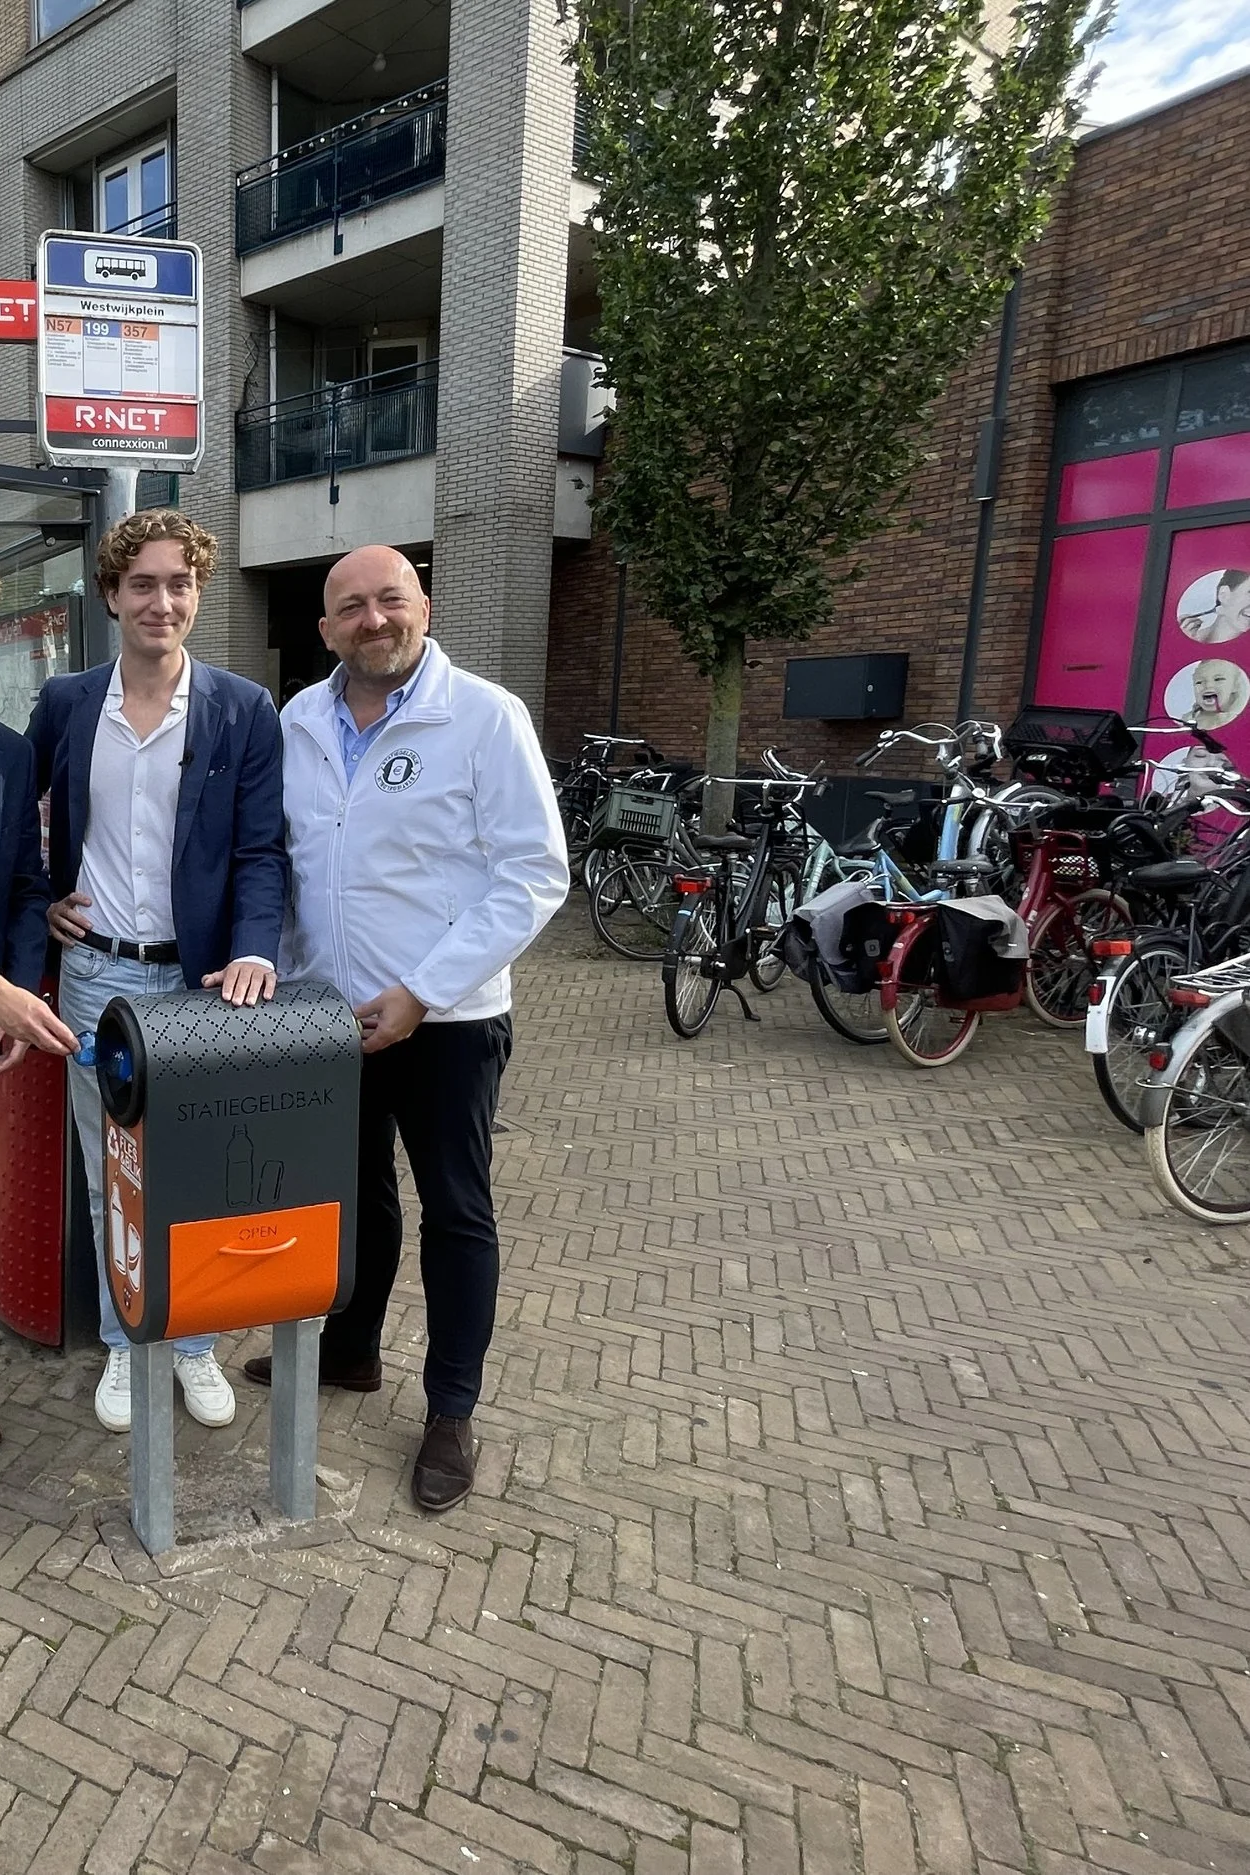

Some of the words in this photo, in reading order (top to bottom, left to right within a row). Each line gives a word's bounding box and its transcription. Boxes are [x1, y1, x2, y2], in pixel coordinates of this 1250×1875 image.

[80, 300, 165, 317] Westwijkplein
[45, 318, 73, 332] N57
[84, 322, 109, 336] 199
[123, 324, 148, 338] 357
[92, 437, 168, 450] connexxion.nl
[177, 1087, 335, 1123] STATIEGELDBAK
[238, 1224, 278, 1241] OPEN
